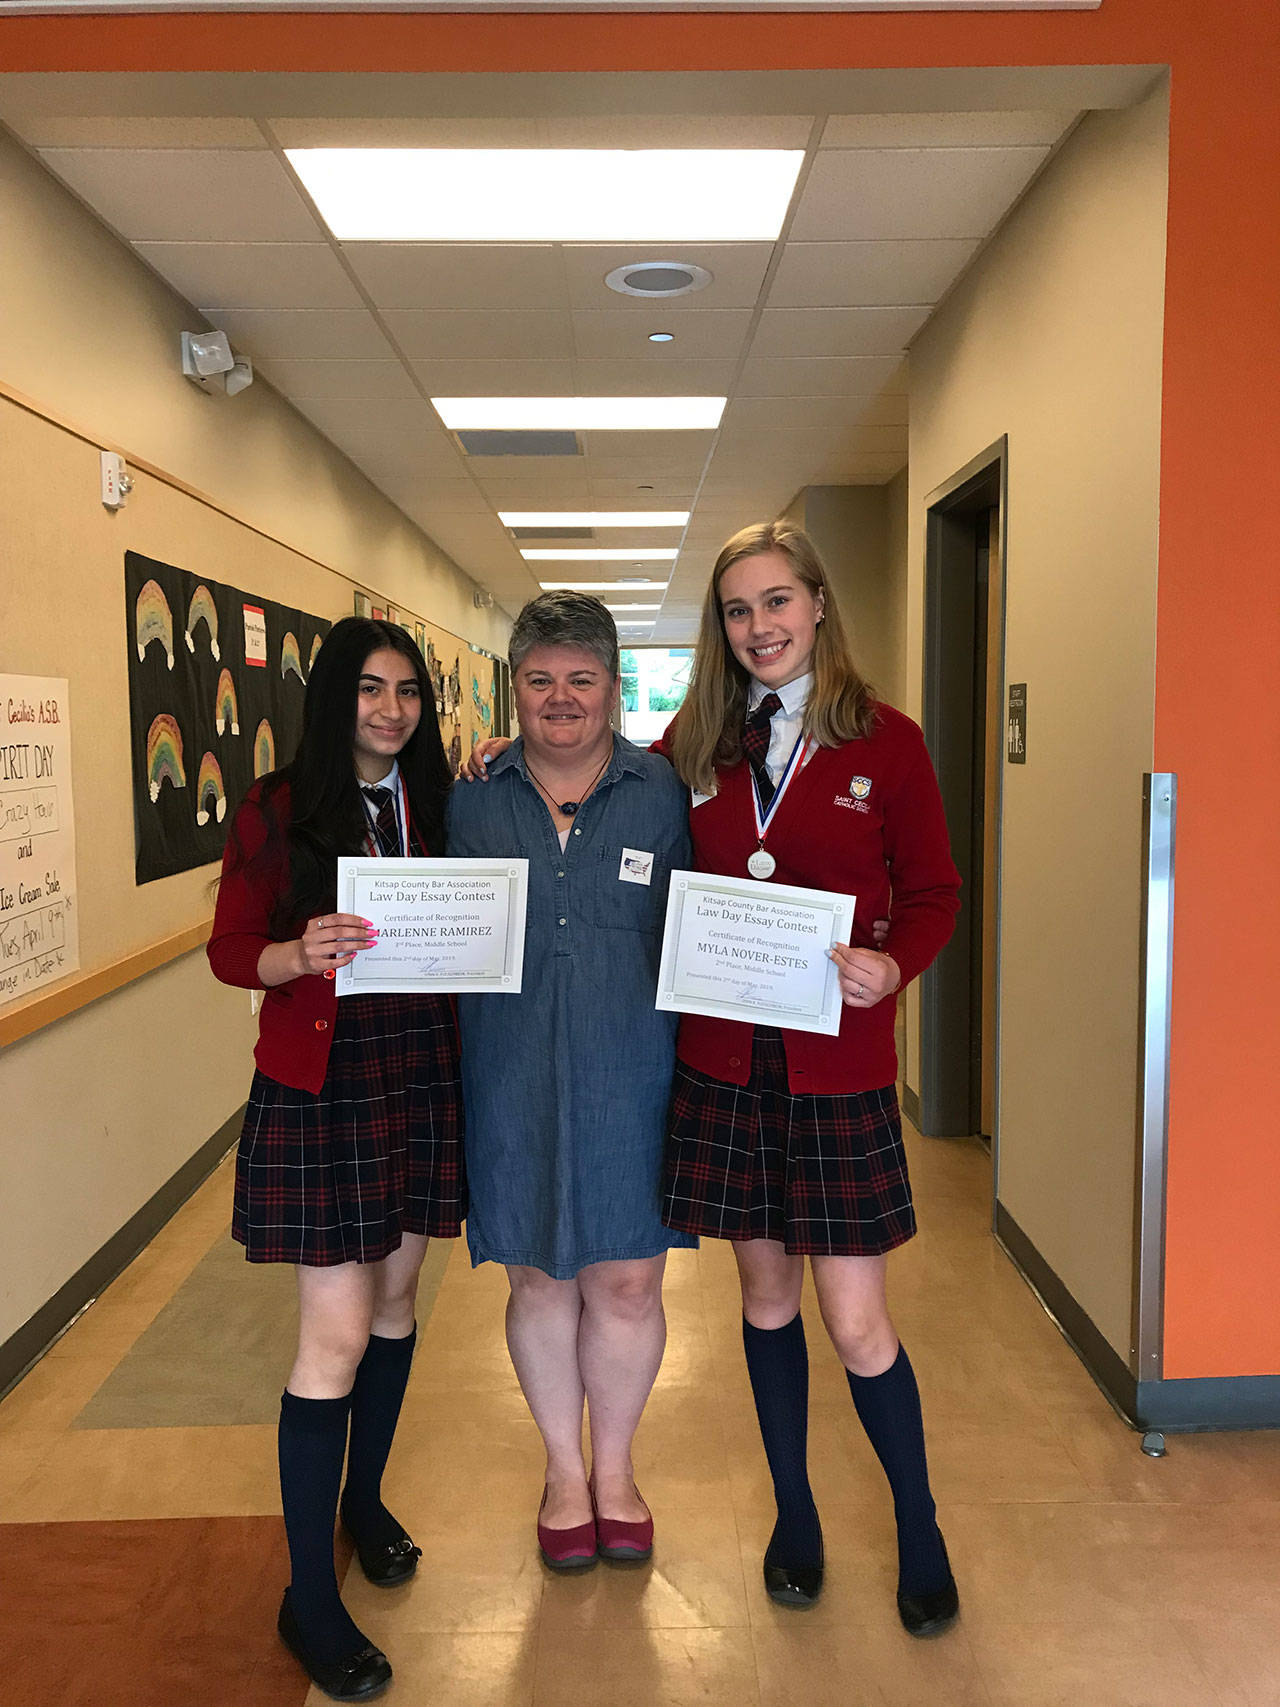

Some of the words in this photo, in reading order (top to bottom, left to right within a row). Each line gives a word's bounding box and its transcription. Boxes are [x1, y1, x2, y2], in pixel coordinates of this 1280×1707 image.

[34, 745, 54, 779] DAY
[17, 838, 33, 860] and
[0, 887, 14, 911] Ice
[18, 882, 42, 905] Cream
[45, 870, 61, 897] Sale
[374, 880, 400, 890] Kitsap
[402, 880, 429, 889] County
[432, 880, 445, 888] Bar
[448, 880, 491, 888] Association
[370, 892, 392, 902] Law
[396, 892, 418, 904] Day
[420, 891, 452, 904] Essay
[454, 891, 495, 902] Contest
[702, 896, 726, 906] Kitsap
[728, 900, 754, 912] County
[756, 904, 770, 913] Bar
[771, 906, 814, 920] Association
[384, 914, 424, 922] Certificate
[425, 914, 434, 922] of
[435, 913, 480, 922] Recognition
[696, 906, 720, 918] Law
[722, 910, 742, 923] Day
[744, 913, 774, 928] Essay
[776, 919, 818, 934] Contest
[440, 926, 492, 936] RAMIREZ
[708, 930, 748, 943] Certificate
[749, 936, 756, 944] of
[756, 938, 800, 952] Recognition
[697, 942, 729, 957] MYLA
[732, 948, 808, 970] NOVER-ESTES
